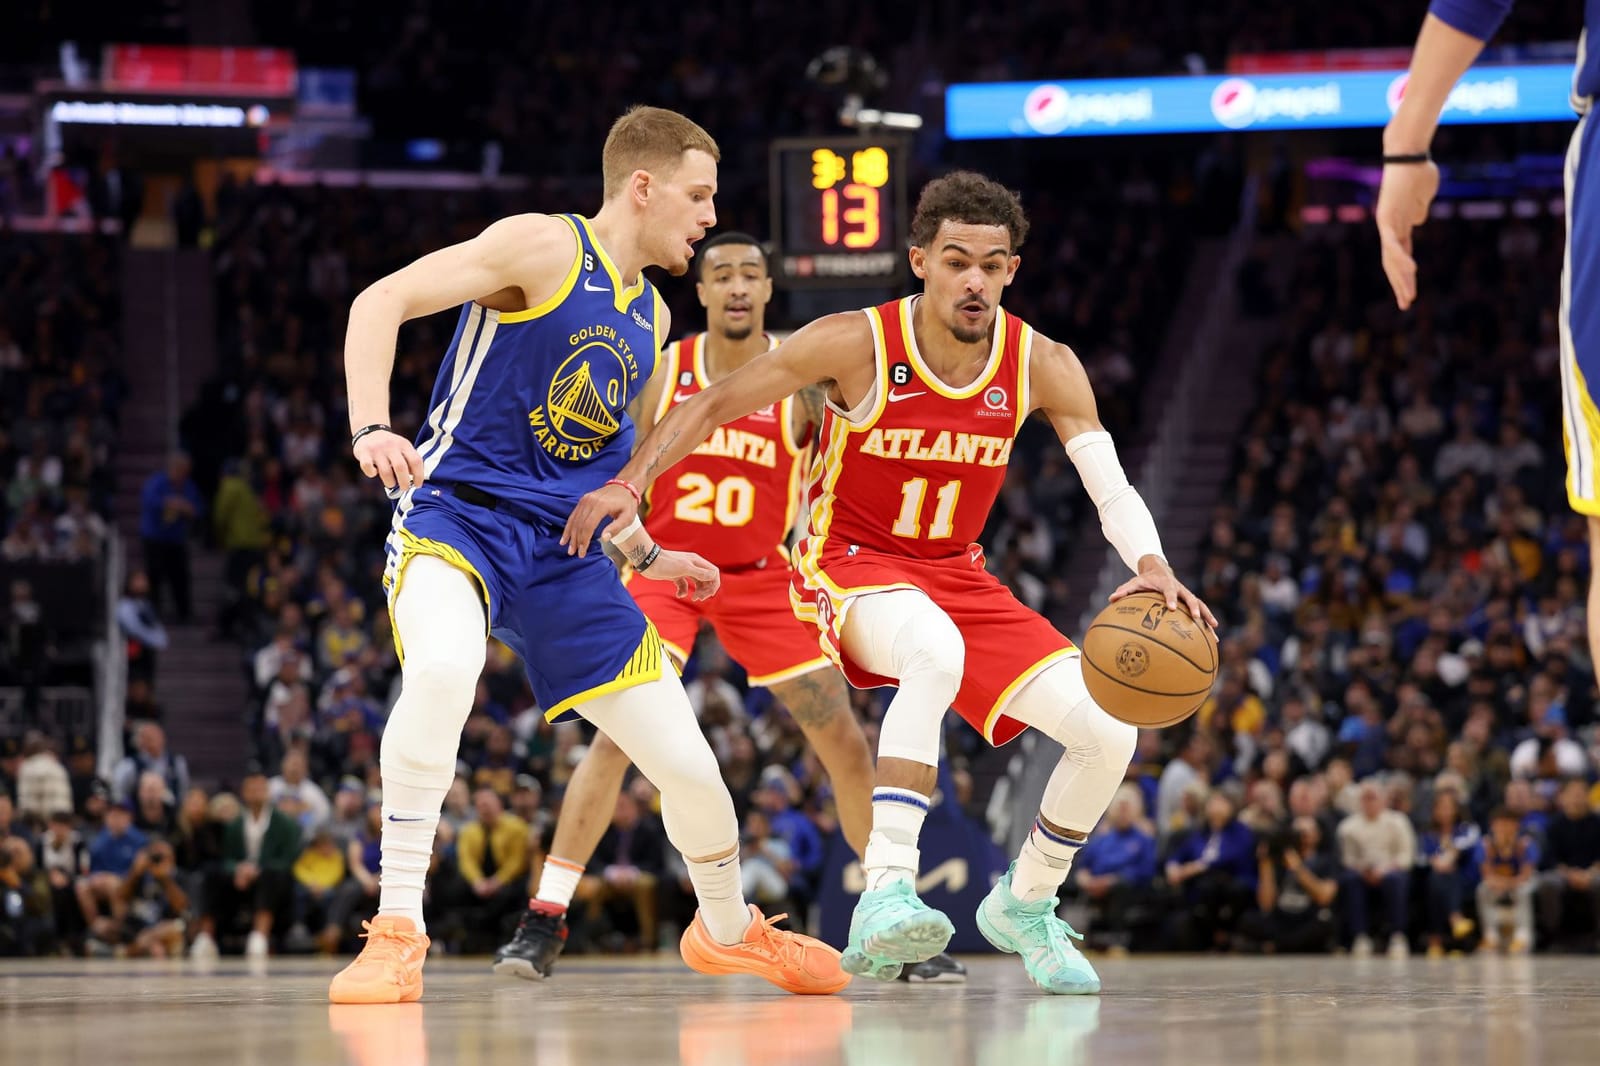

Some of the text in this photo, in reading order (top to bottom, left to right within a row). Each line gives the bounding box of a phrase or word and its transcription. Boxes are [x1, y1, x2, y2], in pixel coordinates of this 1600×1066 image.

[1067, 88, 1153, 128] pepsi
[1254, 81, 1341, 122] pepsi
[822, 183, 880, 249] 13
[584, 253, 594, 271] 6
[569, 325, 639, 381] GOLDEN STATE
[893, 365, 908, 384] 6
[528, 404, 608, 461] WARRIOR
[976, 409, 1012, 418] sharecare
[859, 428, 1013, 467] ATLANTA
[674, 472, 755, 527] 20
[891, 477, 962, 540] 11
